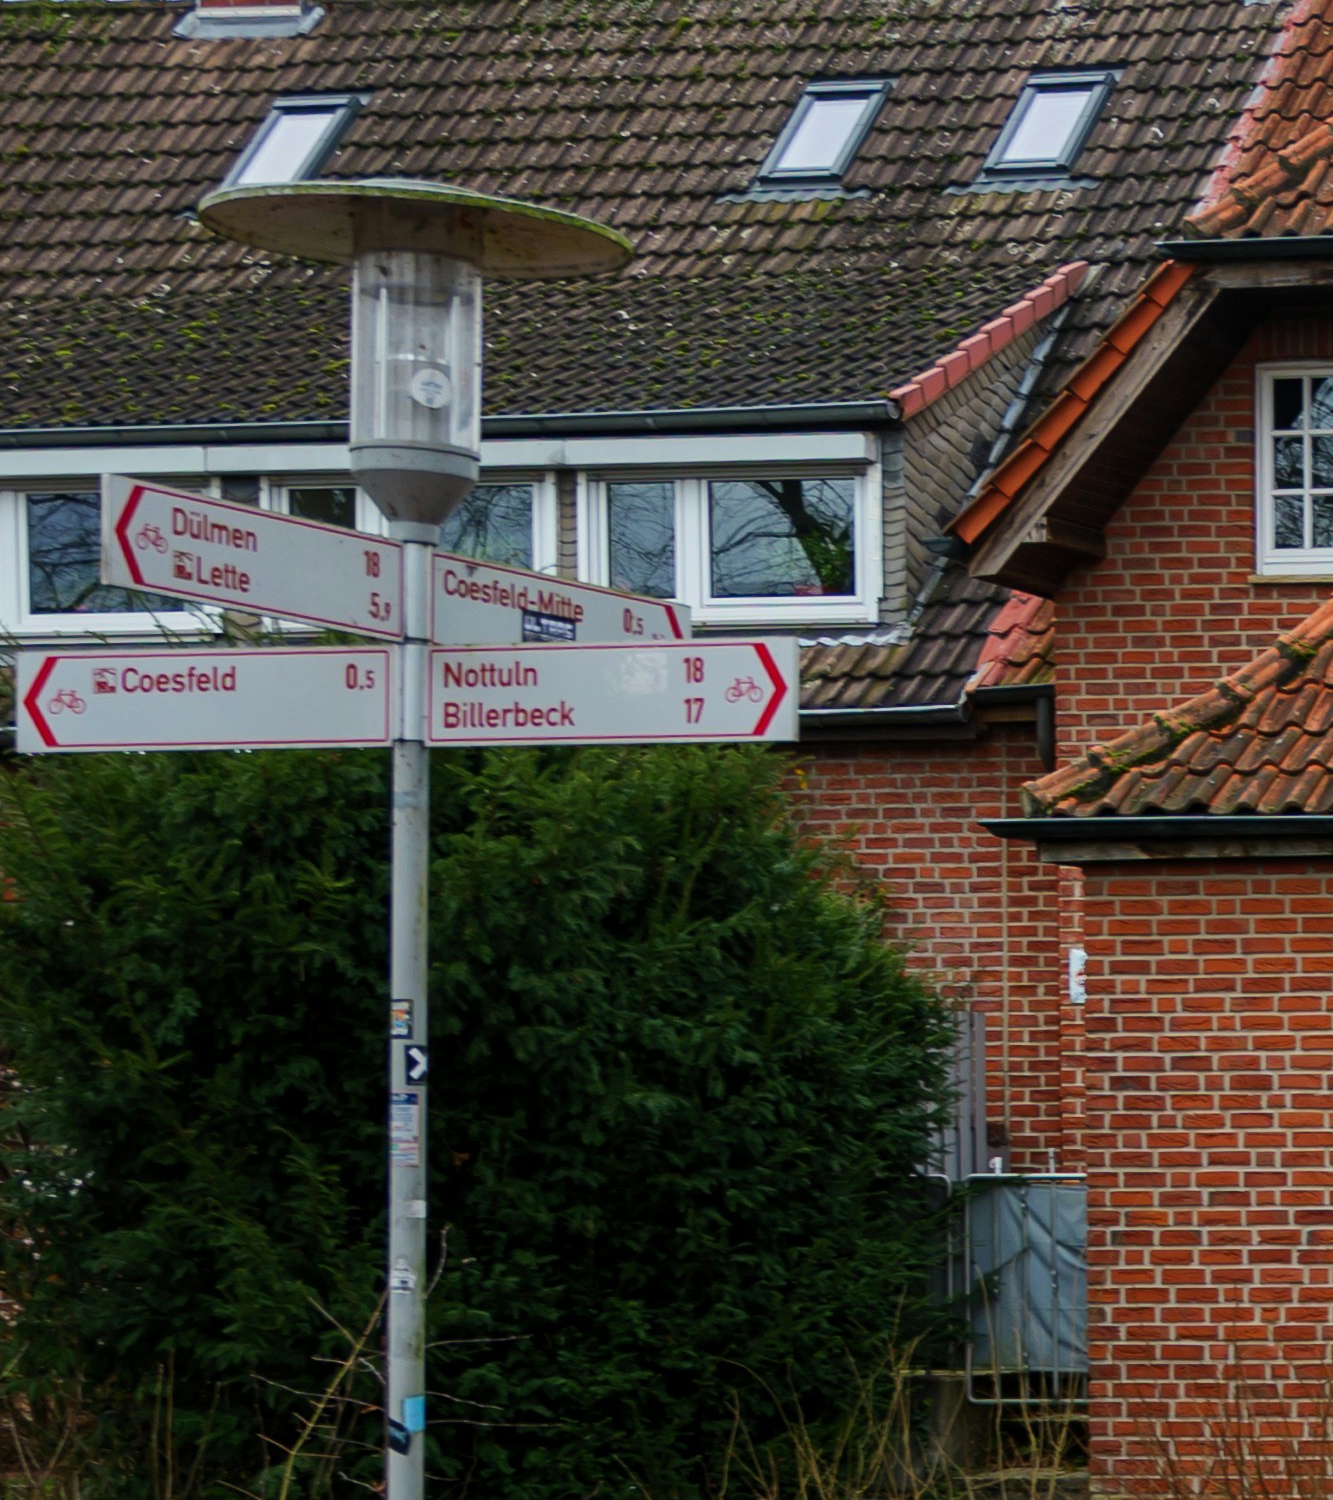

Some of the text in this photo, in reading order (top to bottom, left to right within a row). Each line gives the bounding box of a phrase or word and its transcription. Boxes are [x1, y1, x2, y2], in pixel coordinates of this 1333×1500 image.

[172, 507, 381, 578] Dülmen 18
[195, 556, 250, 593] Lette
[443, 569, 644, 635] Coesfeld-Mitte 0,5
[121, 663, 376, 693] Coesfeld 0,5
[443, 656, 705, 688] Nottuln 18
[443, 697, 705, 729] Billerbeck 17
